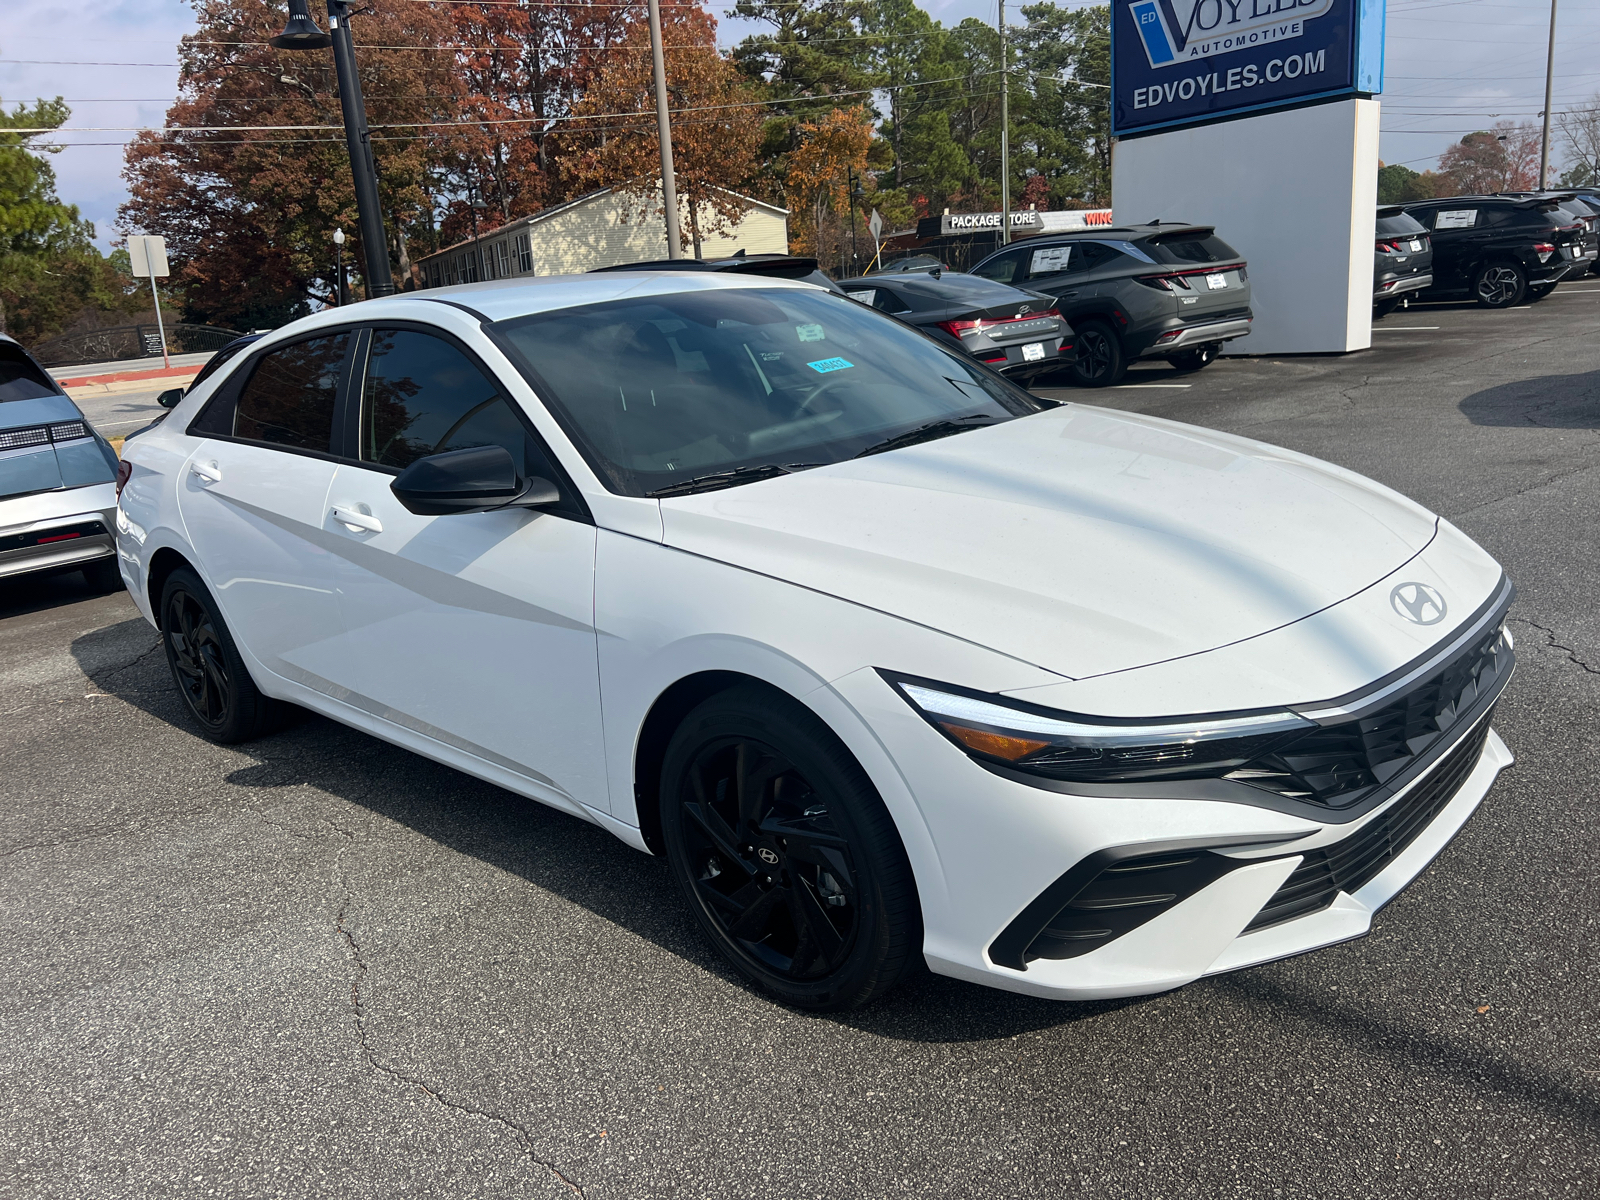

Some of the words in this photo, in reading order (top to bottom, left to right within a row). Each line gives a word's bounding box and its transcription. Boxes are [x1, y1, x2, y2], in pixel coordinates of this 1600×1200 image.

[1141, 12, 1156, 25] ED
[1158, 0, 1317, 53] VOYL
[1190, 22, 1300, 57] AUTOMOTIVE
[1133, 49, 1326, 110] EDVOYLES.COM
[951, 214, 1000, 228] PACKAGE
[1008, 212, 1035, 225] TORE
[1004, 321, 1046, 330] ELANTRA
